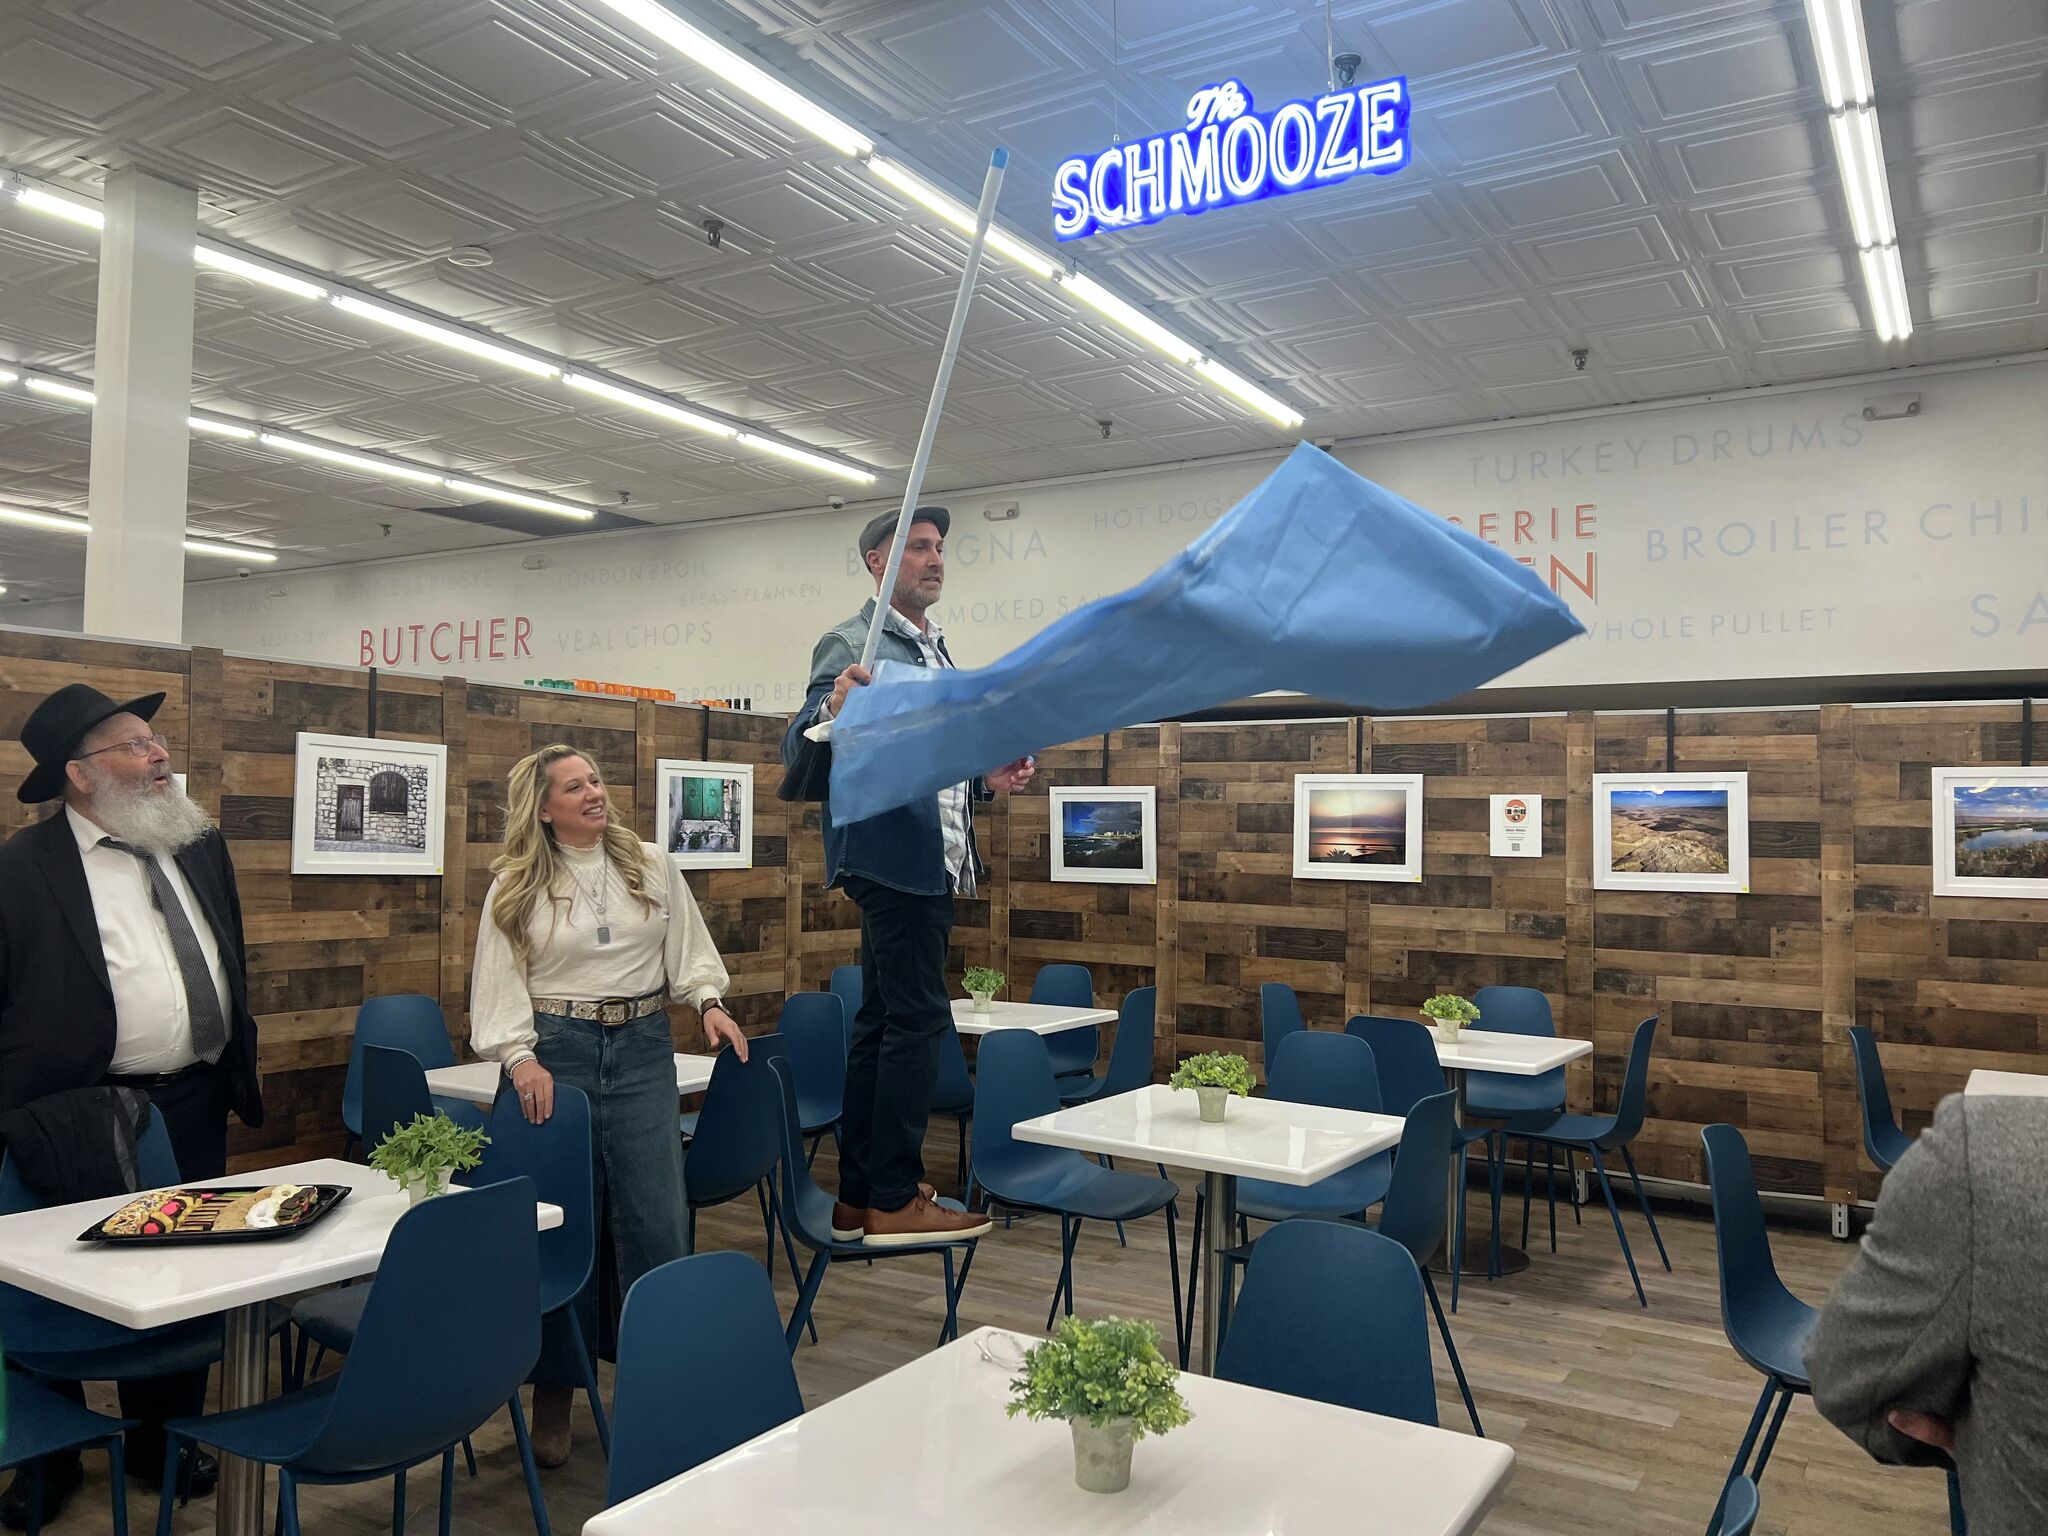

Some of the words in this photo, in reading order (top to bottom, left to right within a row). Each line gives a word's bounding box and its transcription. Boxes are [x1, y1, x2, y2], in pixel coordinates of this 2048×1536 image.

[1186, 80, 1248, 131] The
[1054, 80, 1404, 234] SCHMOOZE
[1467, 438, 1648, 485] TURKEY
[1672, 412, 1863, 467] DRUMS
[1094, 505, 1146, 532] HOT
[1446, 503, 1597, 545] ERIE
[1646, 509, 1889, 562] BROILER
[1919, 496, 2048, 540] CHI
[558, 564, 642, 590] LONDON
[650, 557, 708, 581] BROIL
[846, 528, 1048, 577] BGNA
[1512, 551, 1598, 606] N
[556, 628, 614, 652] VEAL
[624, 619, 713, 649] CHOPS
[931, 597, 1045, 626] SMOKED
[1711, 607, 1838, 637] PULLET
[1968, 590, 2048, 638] SA
[360, 616, 533, 667] BUTCHER
[677, 682, 766, 702] GROUND
[774, 681, 808, 701] BEE
